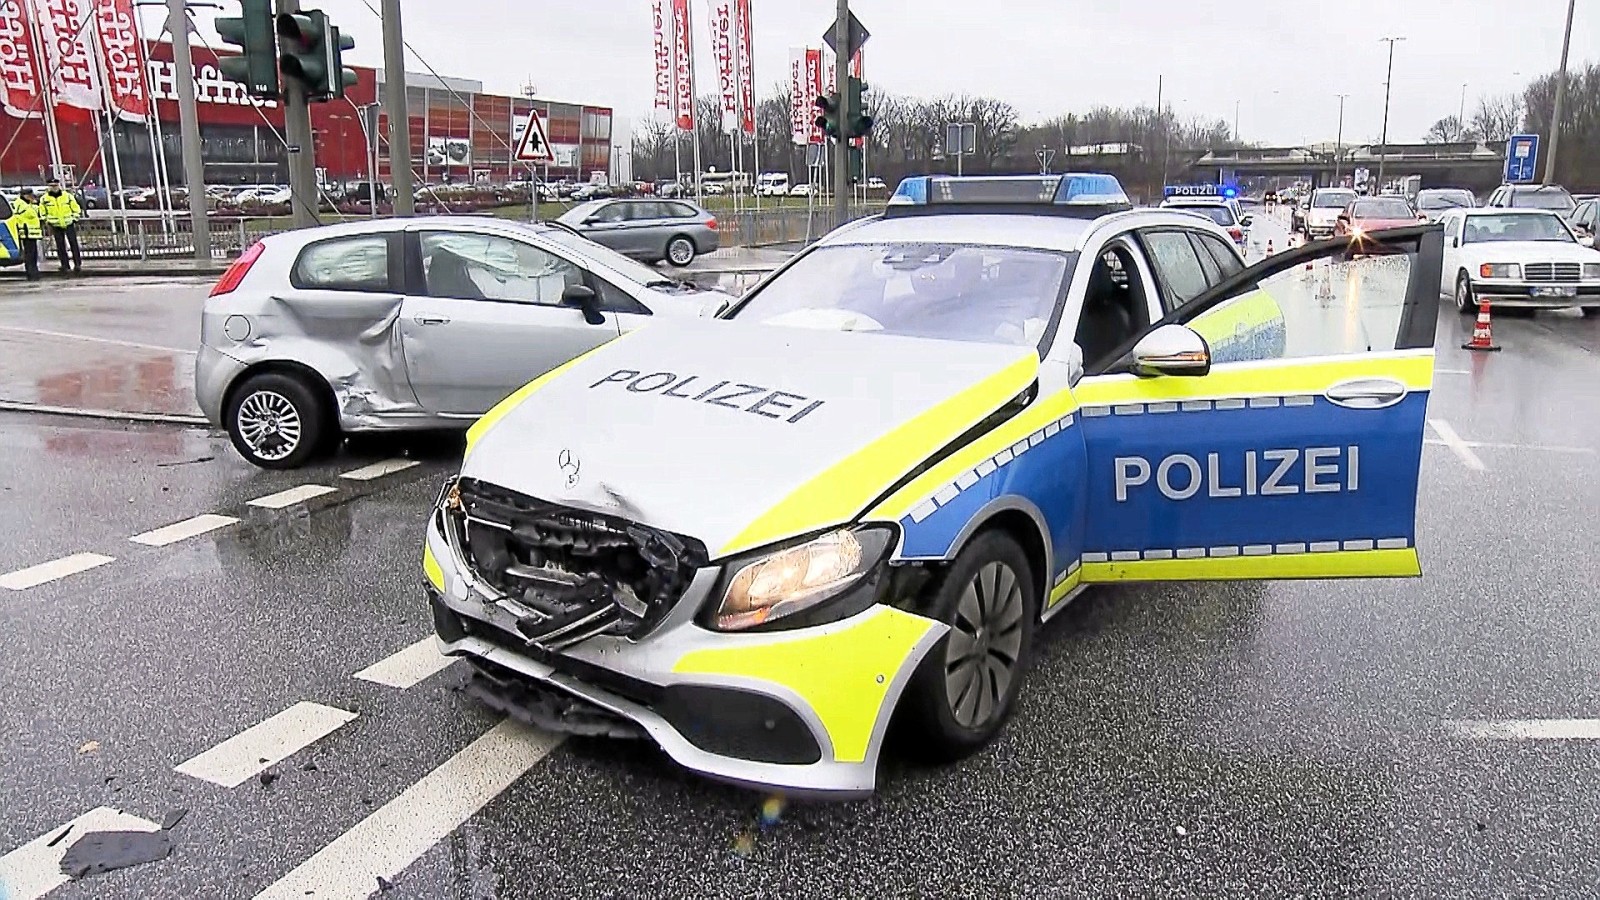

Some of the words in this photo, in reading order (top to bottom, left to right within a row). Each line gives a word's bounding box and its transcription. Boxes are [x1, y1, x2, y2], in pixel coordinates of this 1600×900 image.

[1175, 186, 1217, 195] POLIZEI
[589, 369, 825, 424] POLIZEI
[1115, 445, 1359, 501] POLIZEI
